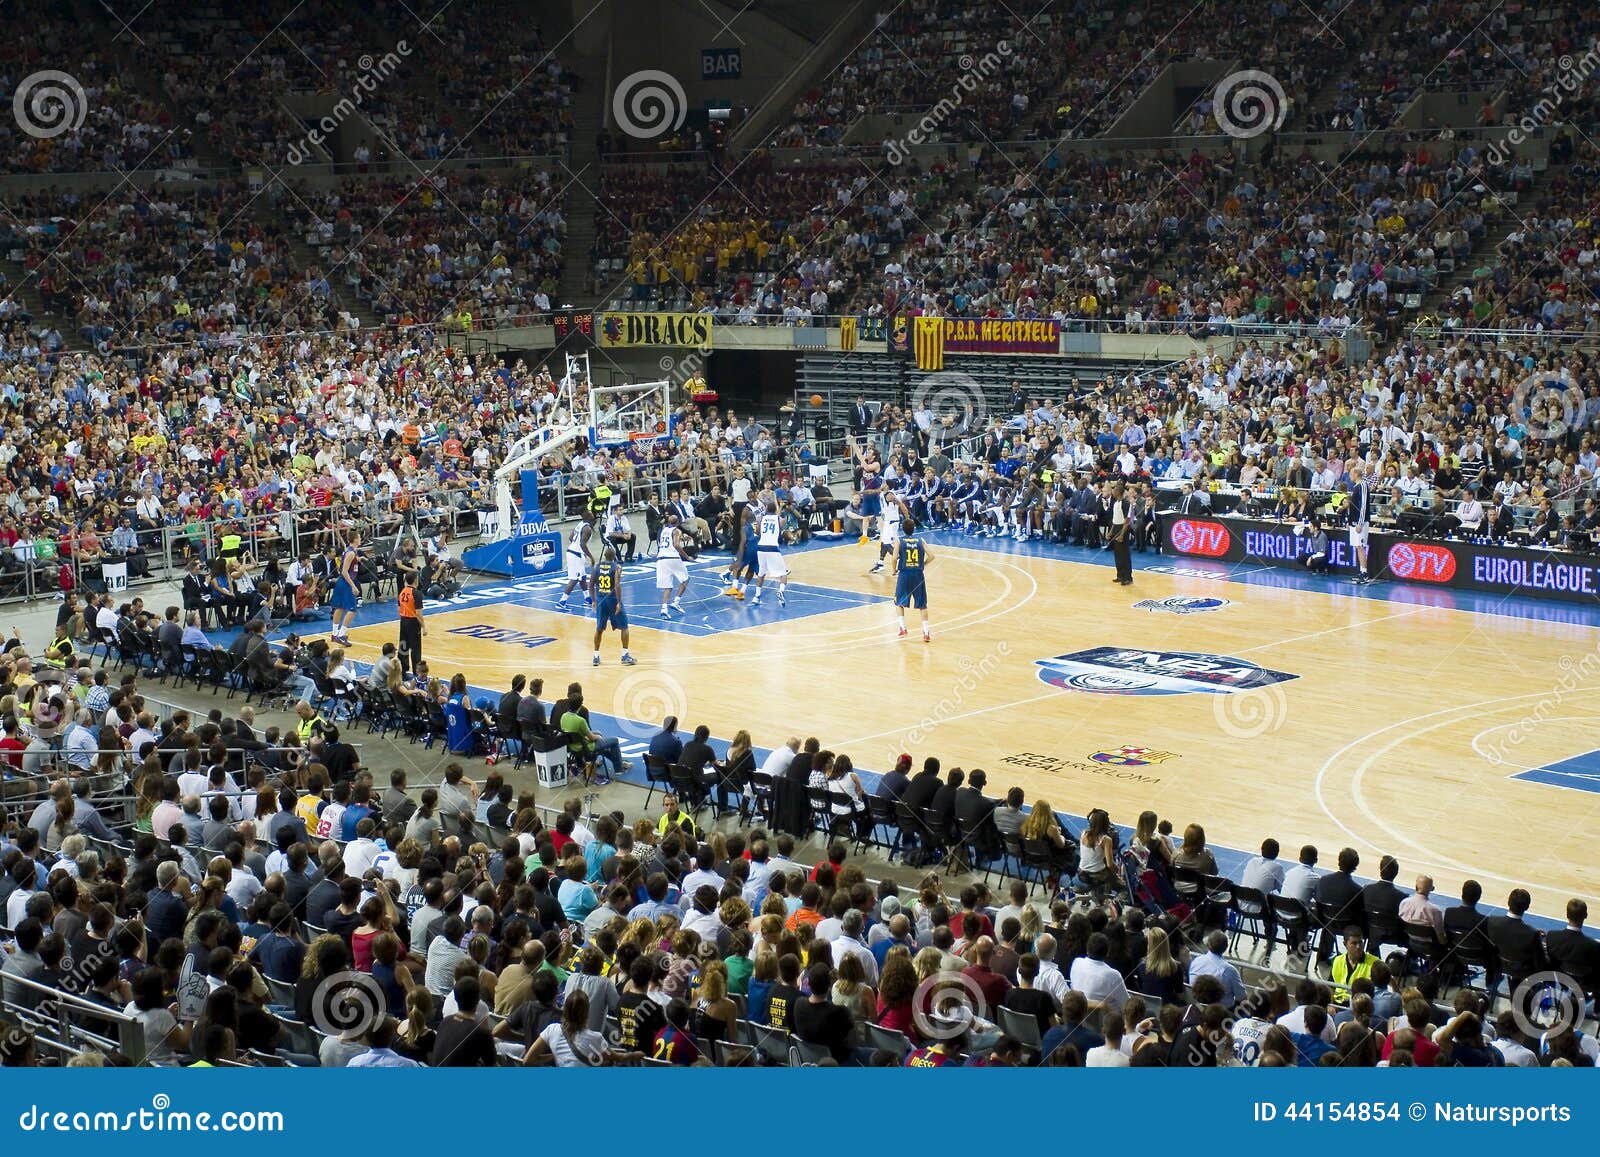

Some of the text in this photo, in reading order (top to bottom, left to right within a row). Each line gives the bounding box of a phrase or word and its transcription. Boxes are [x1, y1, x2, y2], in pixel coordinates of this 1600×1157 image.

[703, 54, 740, 74] BAR
[626, 315, 708, 345] DRACS
[946, 319, 1056, 343] P.B.B. MERITXELL
[520, 521, 550, 536] BBVA
[763, 522, 775, 534] 34
[1196, 527, 1224, 550] TV
[529, 542, 550, 552] NBA
[906, 549, 919, 562] 14
[1418, 551, 1449, 576] TV
[598, 575, 611, 589] 33
[1474, 555, 1600, 594] EUROLEAGUE.
[445, 623, 559, 649] BBVA
[1122, 651, 1258, 680] NBA
[1000, 756, 1064, 773] REGAL
[653, 1037, 676, 1061] 21
[910, 1055, 936, 1067] MESSI
